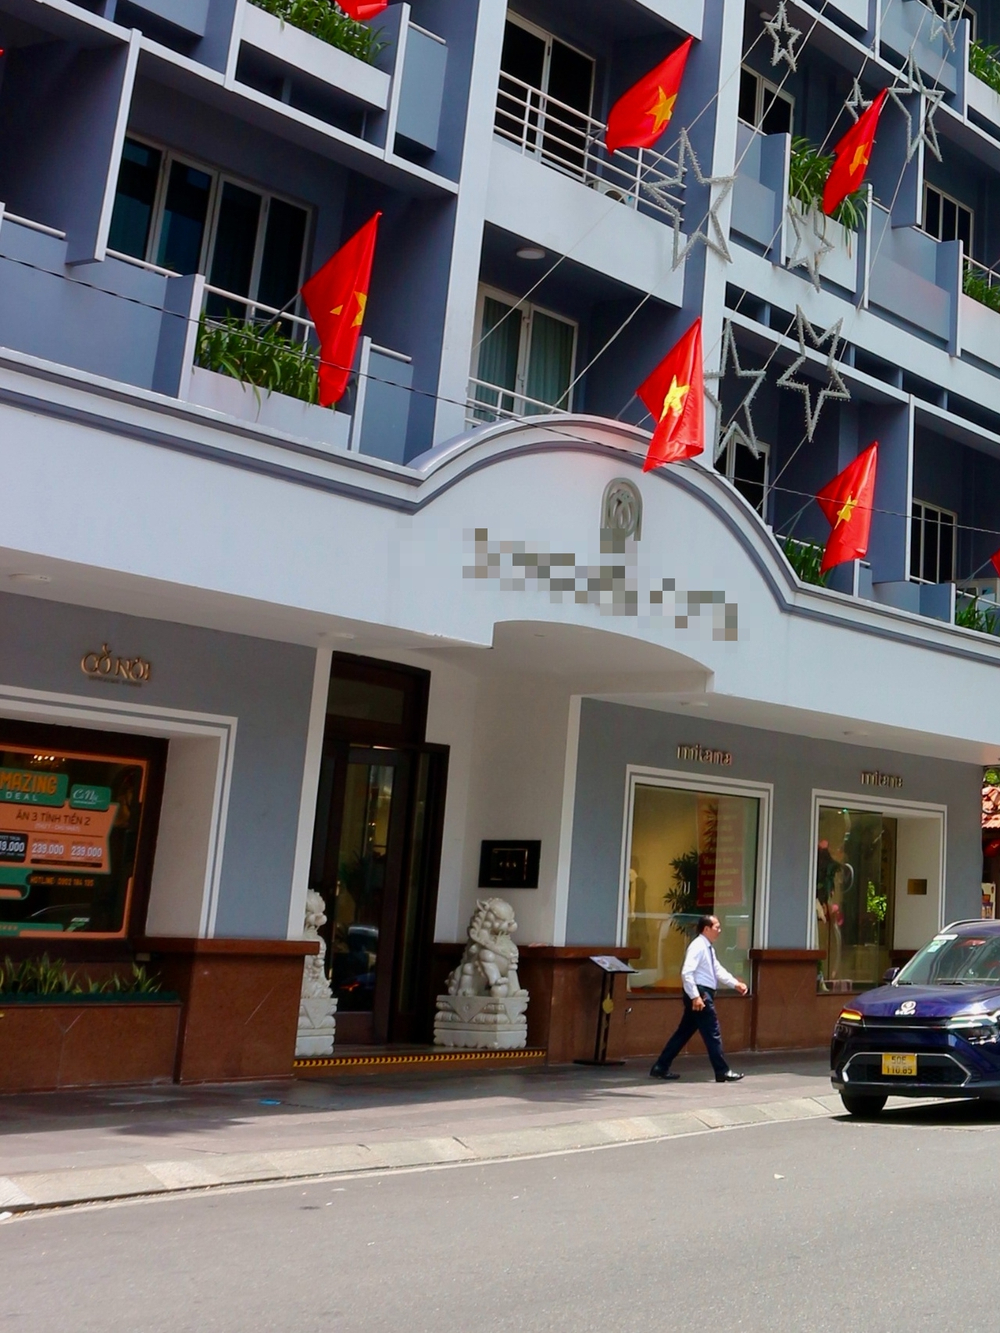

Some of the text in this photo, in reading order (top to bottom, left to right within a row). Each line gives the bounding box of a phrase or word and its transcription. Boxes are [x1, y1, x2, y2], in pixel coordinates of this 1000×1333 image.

[0, 771, 57, 795] MAZING
[5, 792, 38, 802] DEAL
[31, 812, 38, 821] 3
[84, 816, 91, 826] 2
[31, 843, 64, 855] 239.000
[71, 846, 102, 857] 239.000
[891, 1055, 907, 1065] 50E
